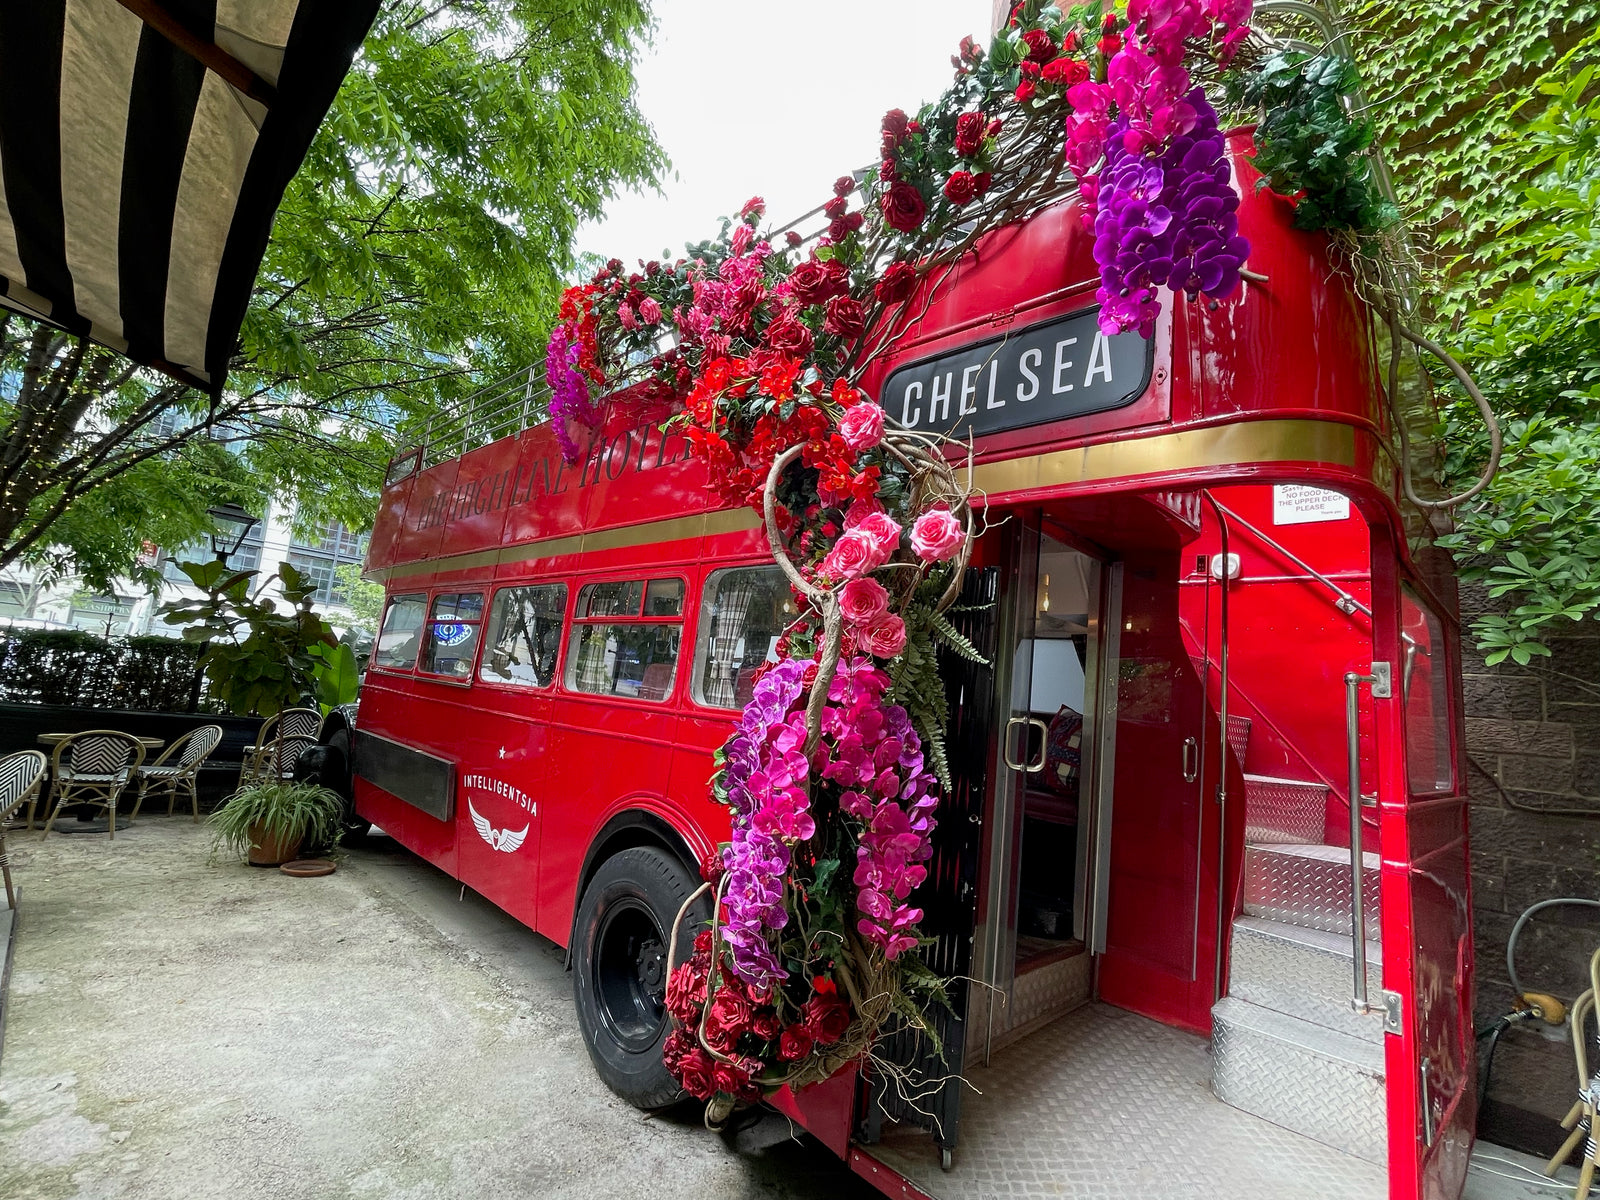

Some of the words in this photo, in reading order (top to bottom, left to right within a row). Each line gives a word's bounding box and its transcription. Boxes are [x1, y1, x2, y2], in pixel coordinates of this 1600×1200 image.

[901, 330, 1113, 428] CHELSEA
[416, 490, 452, 531] THE
[451, 470, 509, 521] HIGH
[510, 454, 570, 506] LINE
[84, 604, 130, 614] ASHBURN
[463, 774, 537, 817] INTELLIGENTSIA
